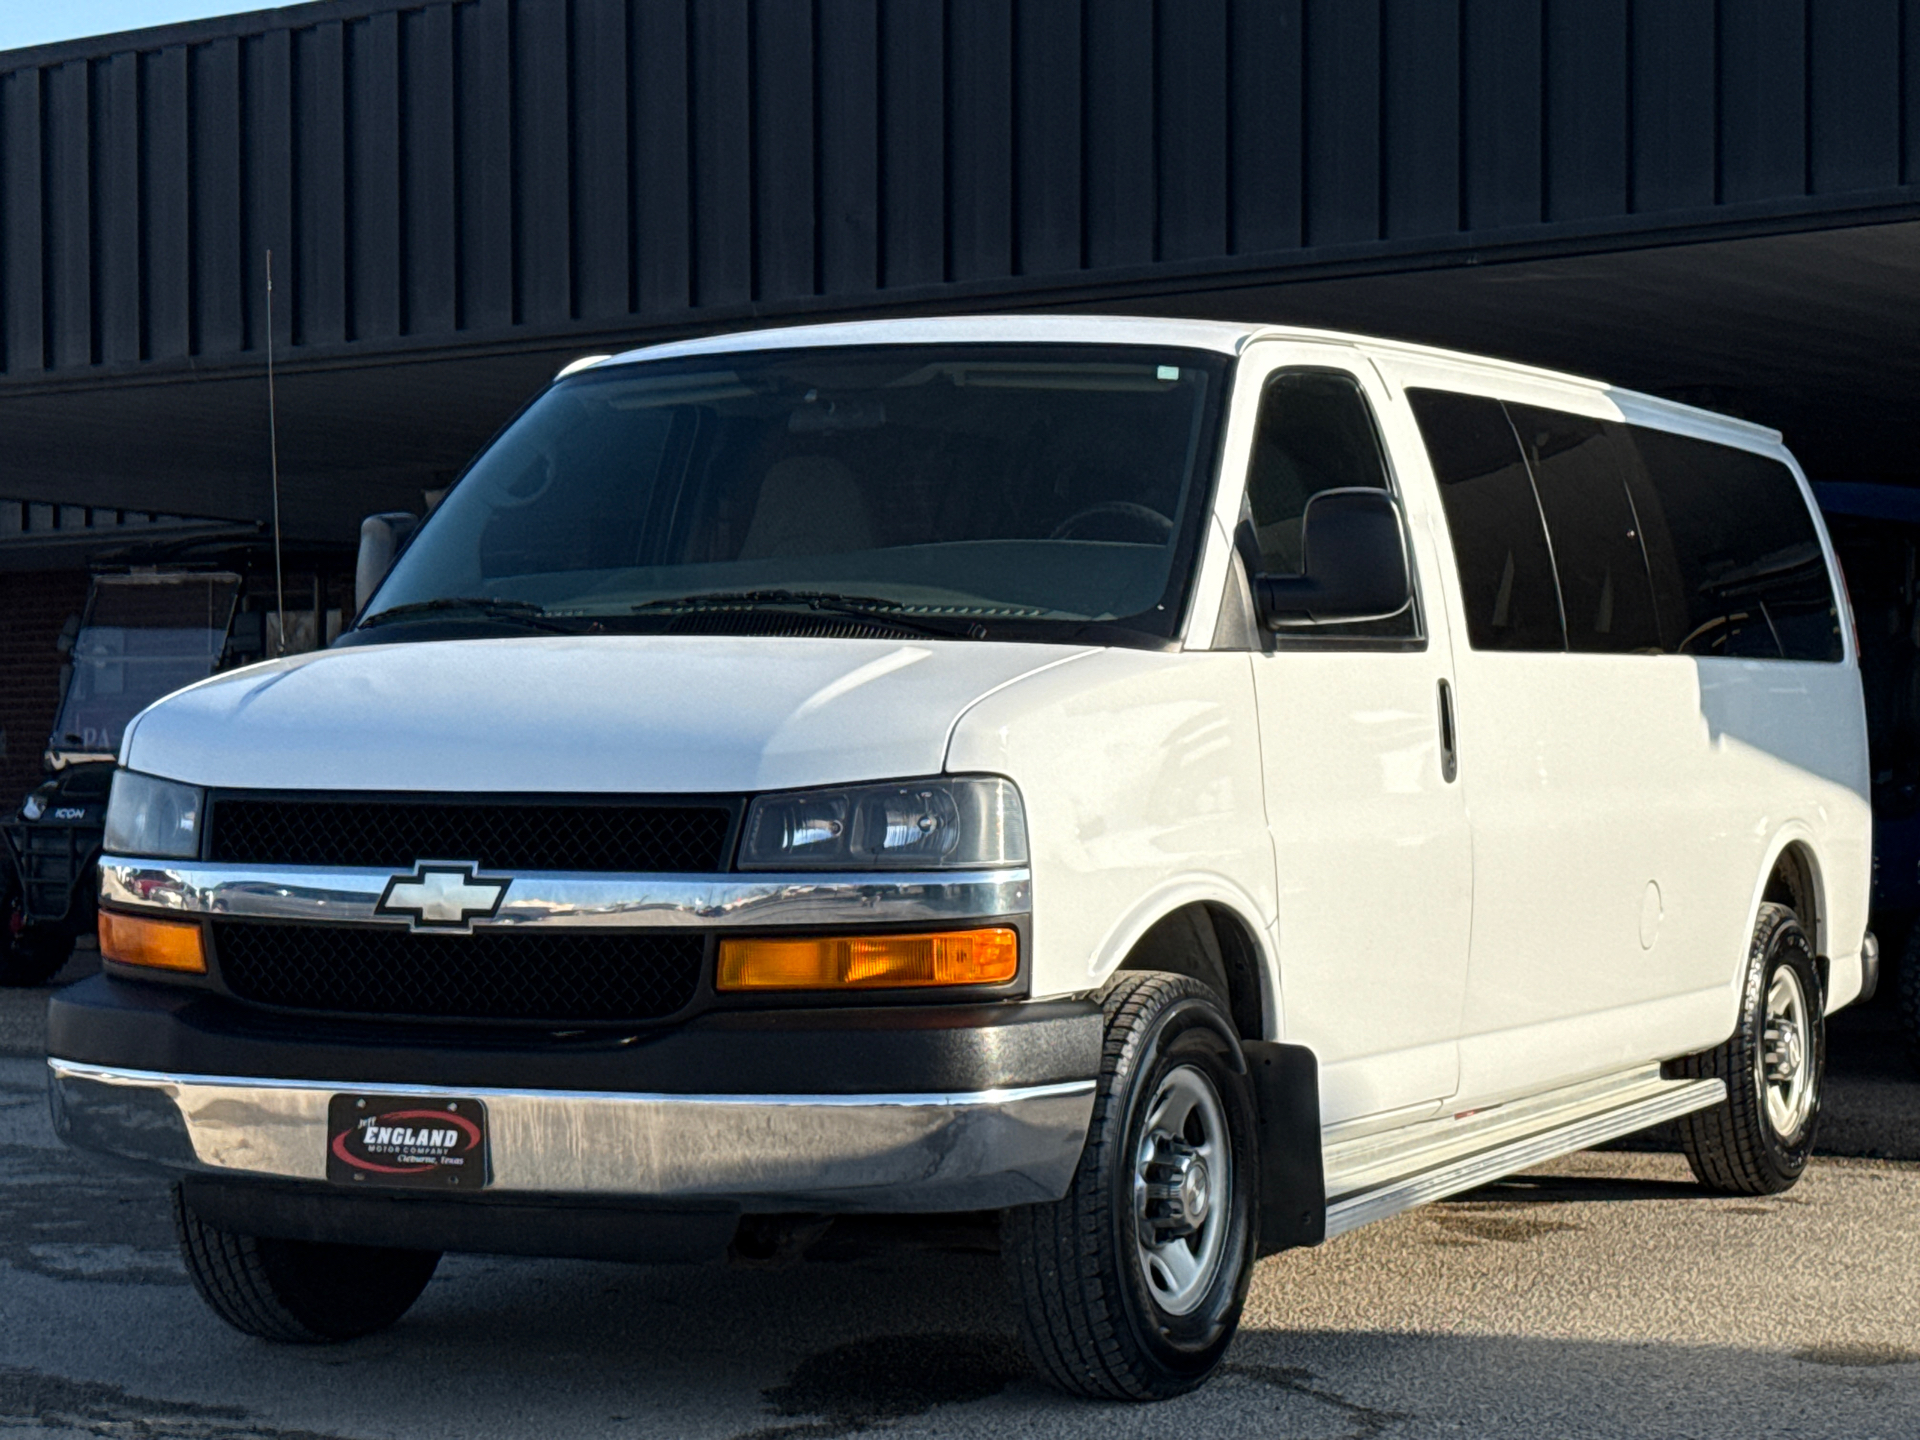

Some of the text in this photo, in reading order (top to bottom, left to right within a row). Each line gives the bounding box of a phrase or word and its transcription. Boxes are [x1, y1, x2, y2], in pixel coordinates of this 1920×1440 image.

[55, 808, 85, 819] ICON
[363, 1126, 458, 1147] ENGLAND
[368, 1145, 449, 1155] MOTOR COMPANY
[440, 1156, 464, 1165] Texas
